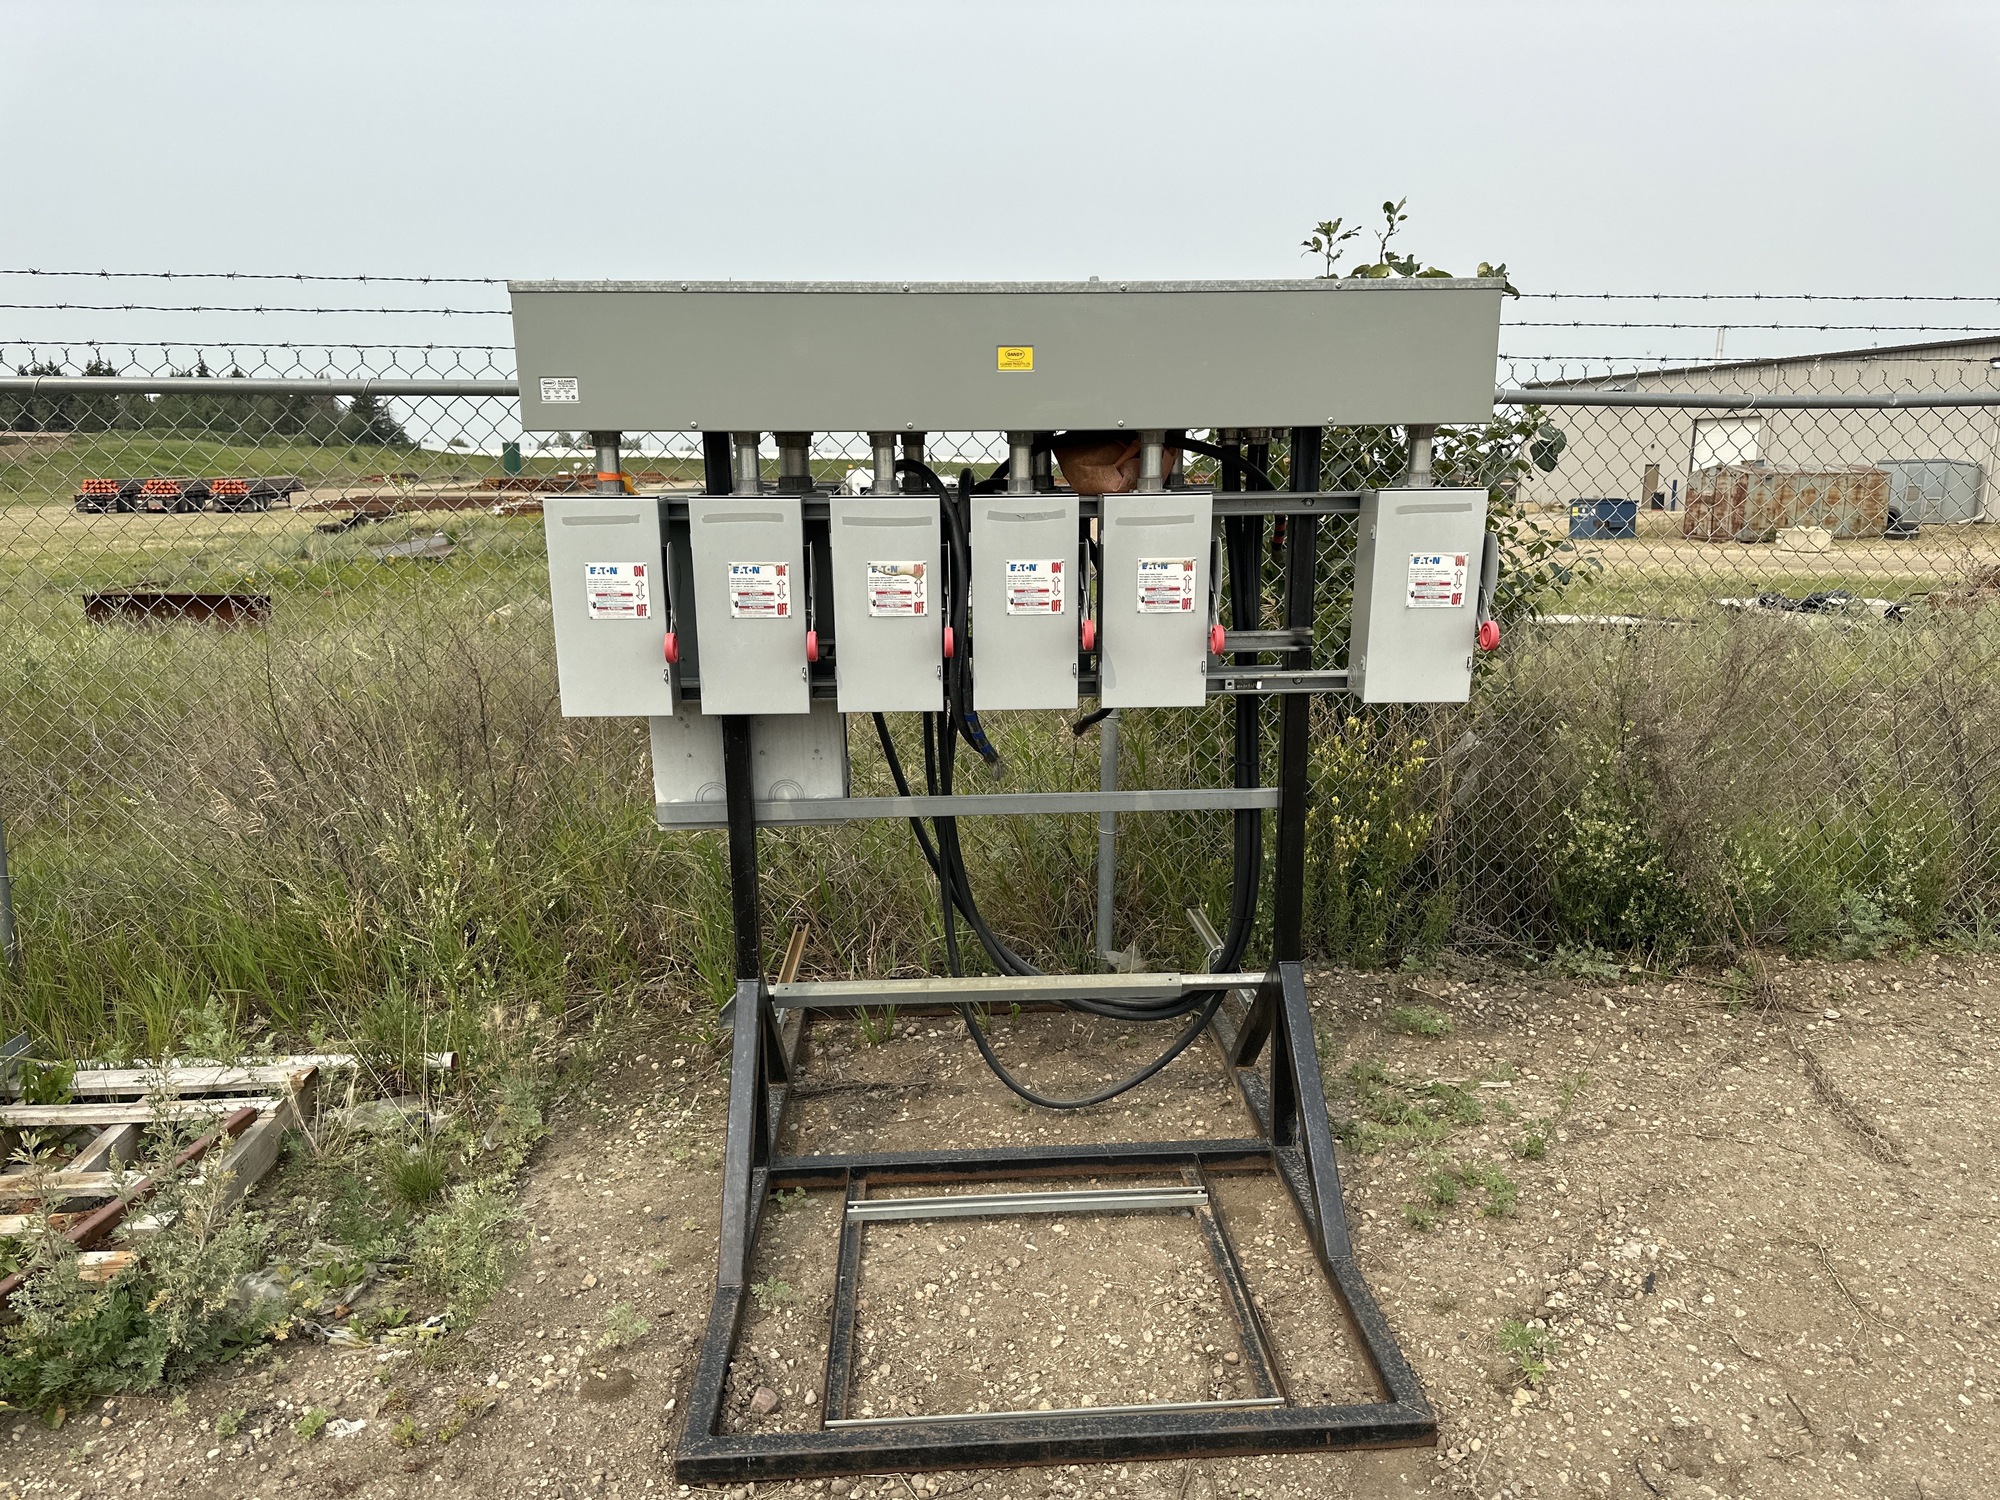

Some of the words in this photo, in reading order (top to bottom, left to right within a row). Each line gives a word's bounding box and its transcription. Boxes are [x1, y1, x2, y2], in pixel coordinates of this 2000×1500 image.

[1455, 555, 1466, 567] ON
[589, 566, 618, 575] EATON
[633, 565, 644, 577] ON
[732, 566, 760, 574] EATON
[775, 565, 786, 576] ON
[1051, 562, 1062, 573] ON
[1181, 597, 1193, 610] OFF
[1451, 592, 1463, 606] OFF
[636, 604, 647, 617] OFF
[777, 603, 788, 616] OFF
[914, 601, 925, 614] OFF
[1051, 599, 1062, 612] OFF
